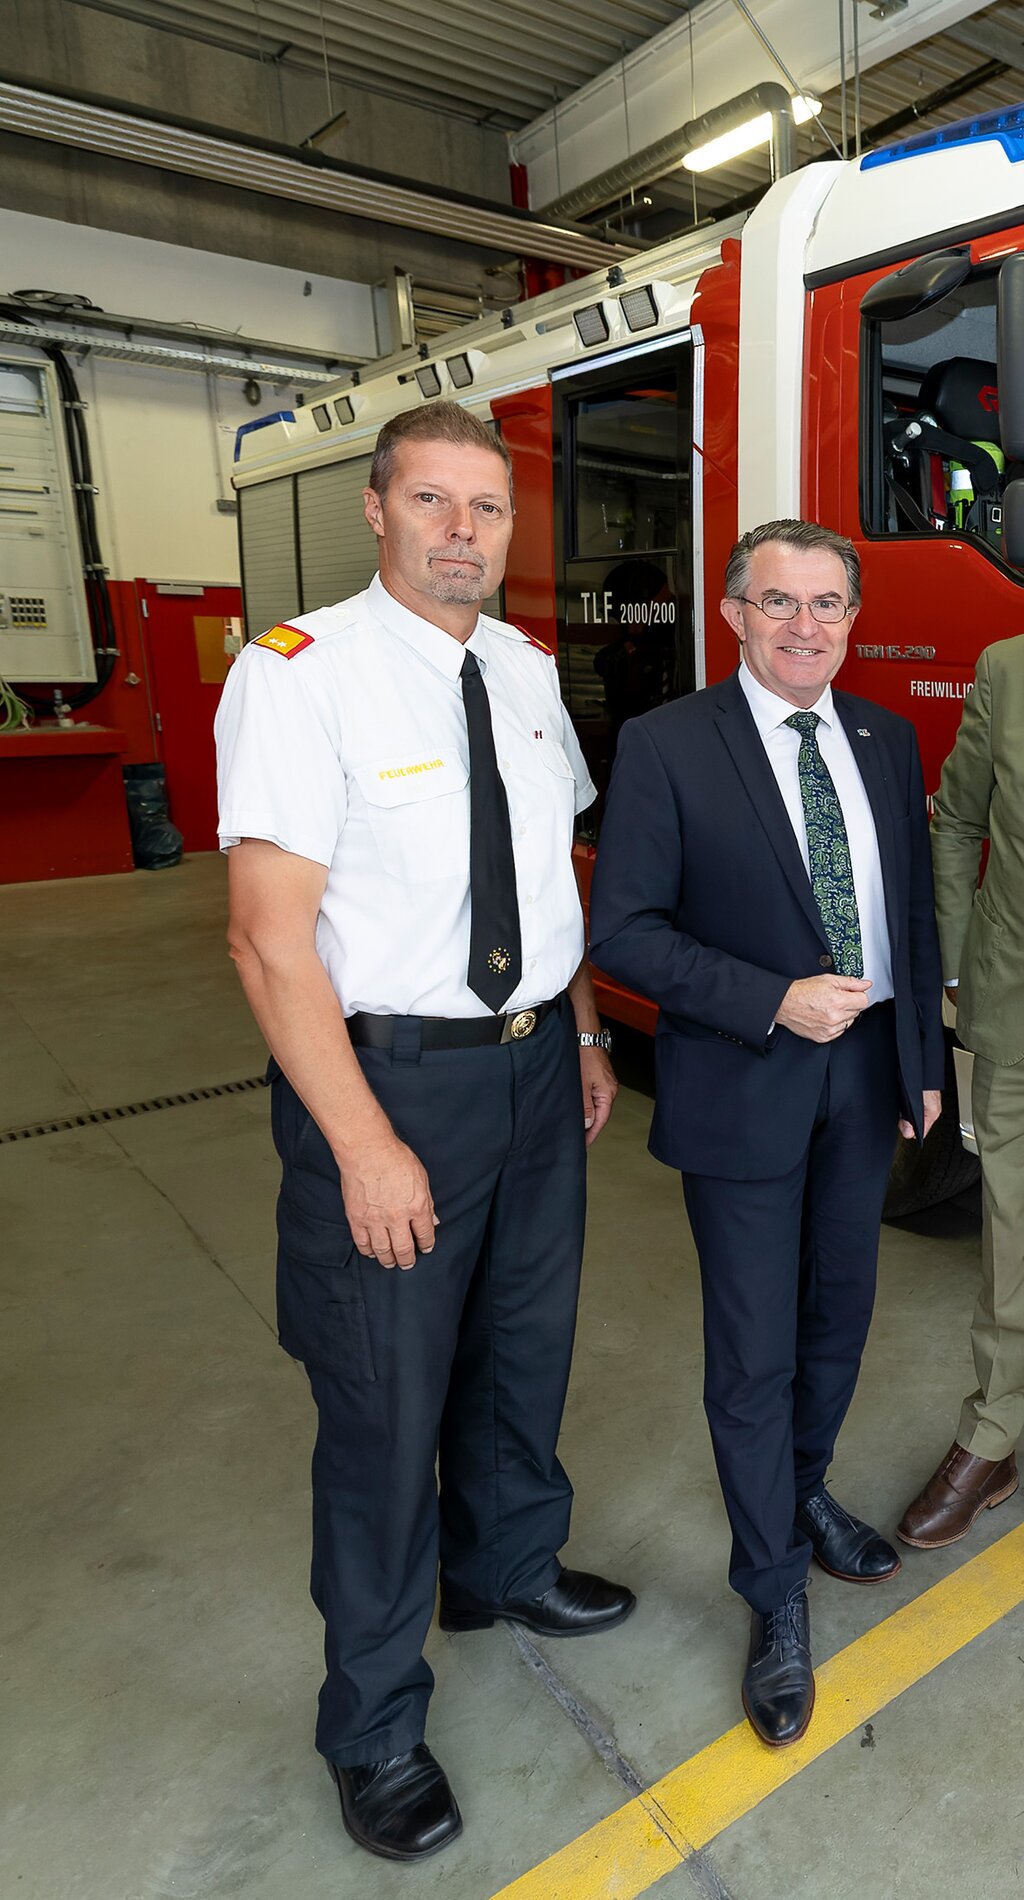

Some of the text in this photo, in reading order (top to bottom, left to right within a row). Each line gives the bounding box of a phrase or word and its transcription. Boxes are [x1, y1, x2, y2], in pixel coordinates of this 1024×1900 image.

[581, 591, 675, 626] TLF 2000/200
[379, 759, 445, 781] FEUERWEHR
